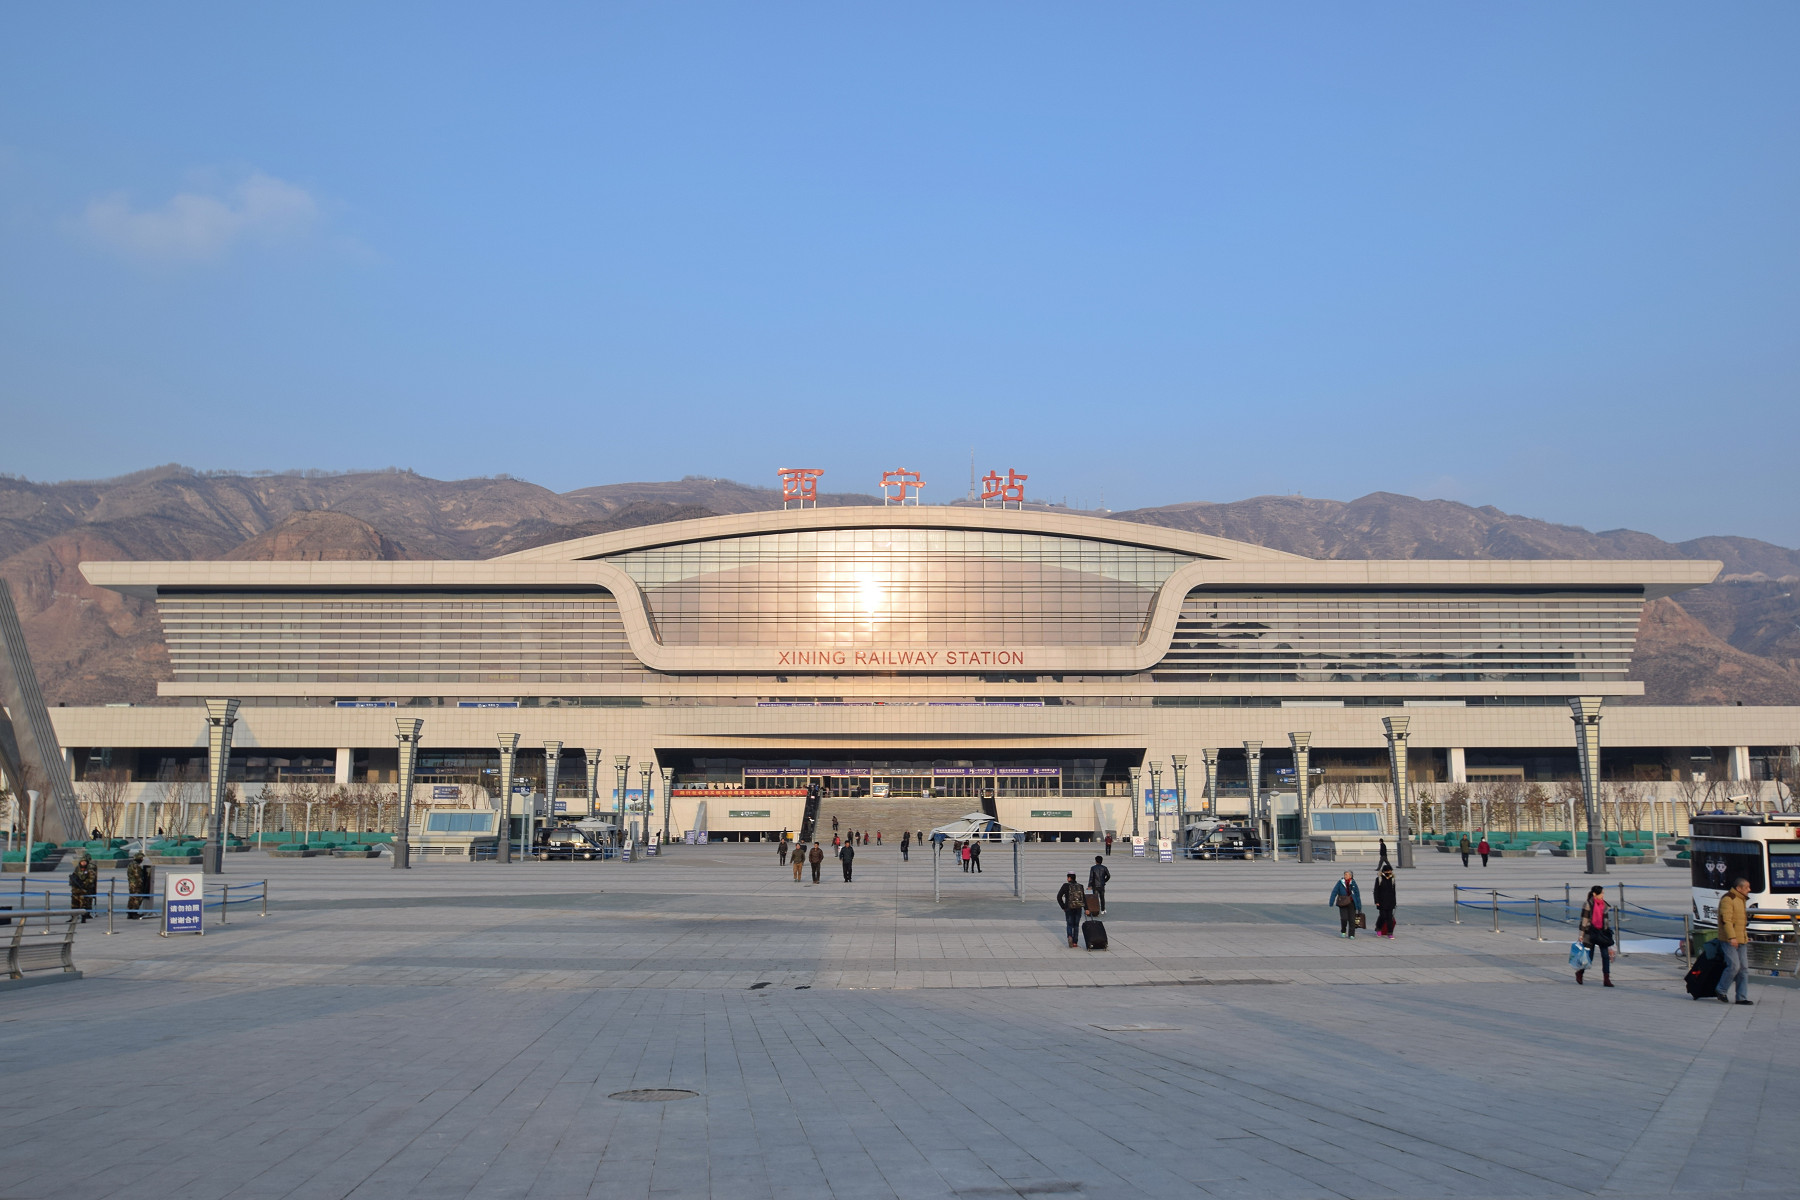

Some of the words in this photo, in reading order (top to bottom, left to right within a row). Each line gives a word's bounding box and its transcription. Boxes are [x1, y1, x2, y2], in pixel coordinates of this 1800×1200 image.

[777, 467, 1028, 502] 西宁站
[778, 651, 845, 665] XINING
[855, 651, 938, 665] RAILWAY
[946, 651, 1024, 665] STATION
[1776, 870, 1800, 878] 报警
[170, 916, 200, 924] 谢谢合作
